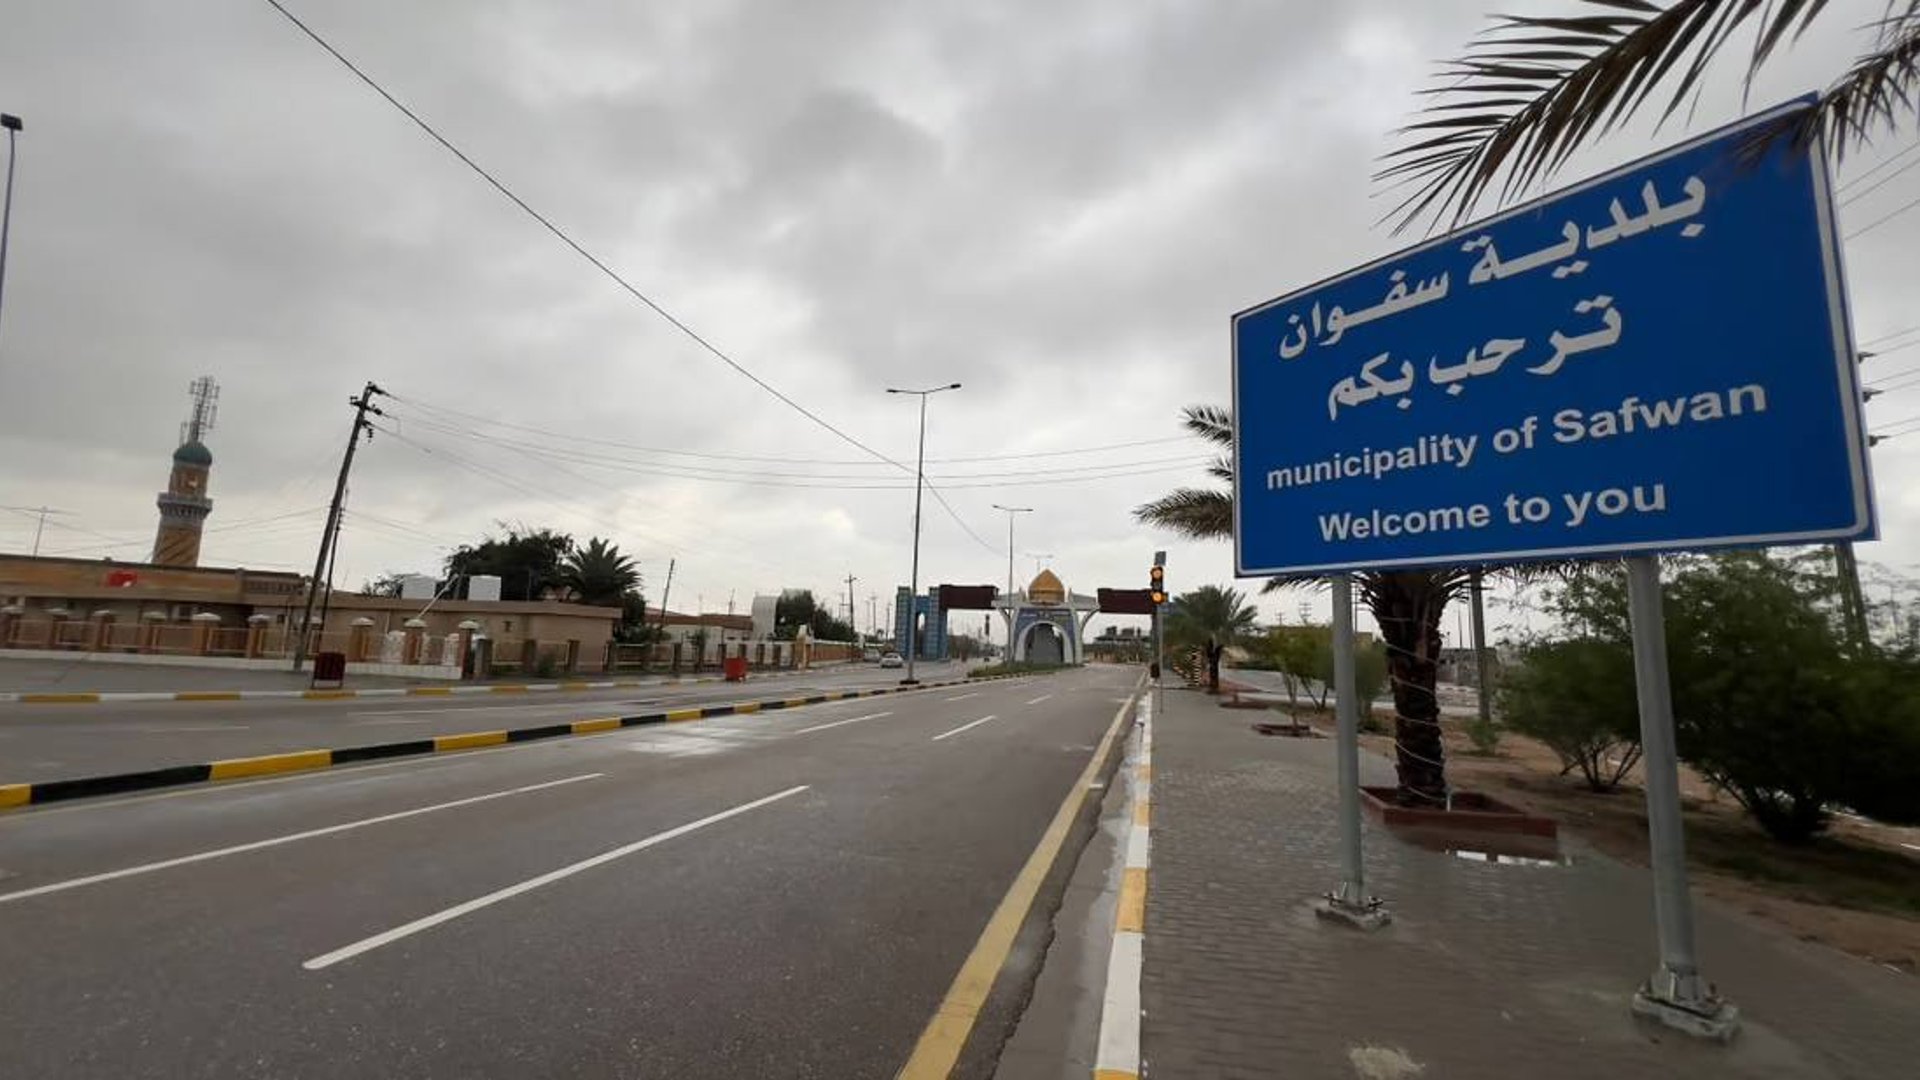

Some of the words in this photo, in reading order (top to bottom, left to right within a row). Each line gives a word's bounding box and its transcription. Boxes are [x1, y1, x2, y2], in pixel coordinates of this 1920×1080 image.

[1461, 175, 1707, 285] بلدية
[1279, 269, 1450, 359] سفوان
[1428, 294, 1623, 396] ترحب
[1327, 351, 1415, 422] بكم
[1266, 434, 1478, 490] municipality
[1493, 416, 1538, 452] of
[1553, 384, 1766, 443] Safwan
[1318, 504, 1491, 542] Welcome
[1503, 494, 1551, 525] to
[1564, 484, 1667, 527] you
